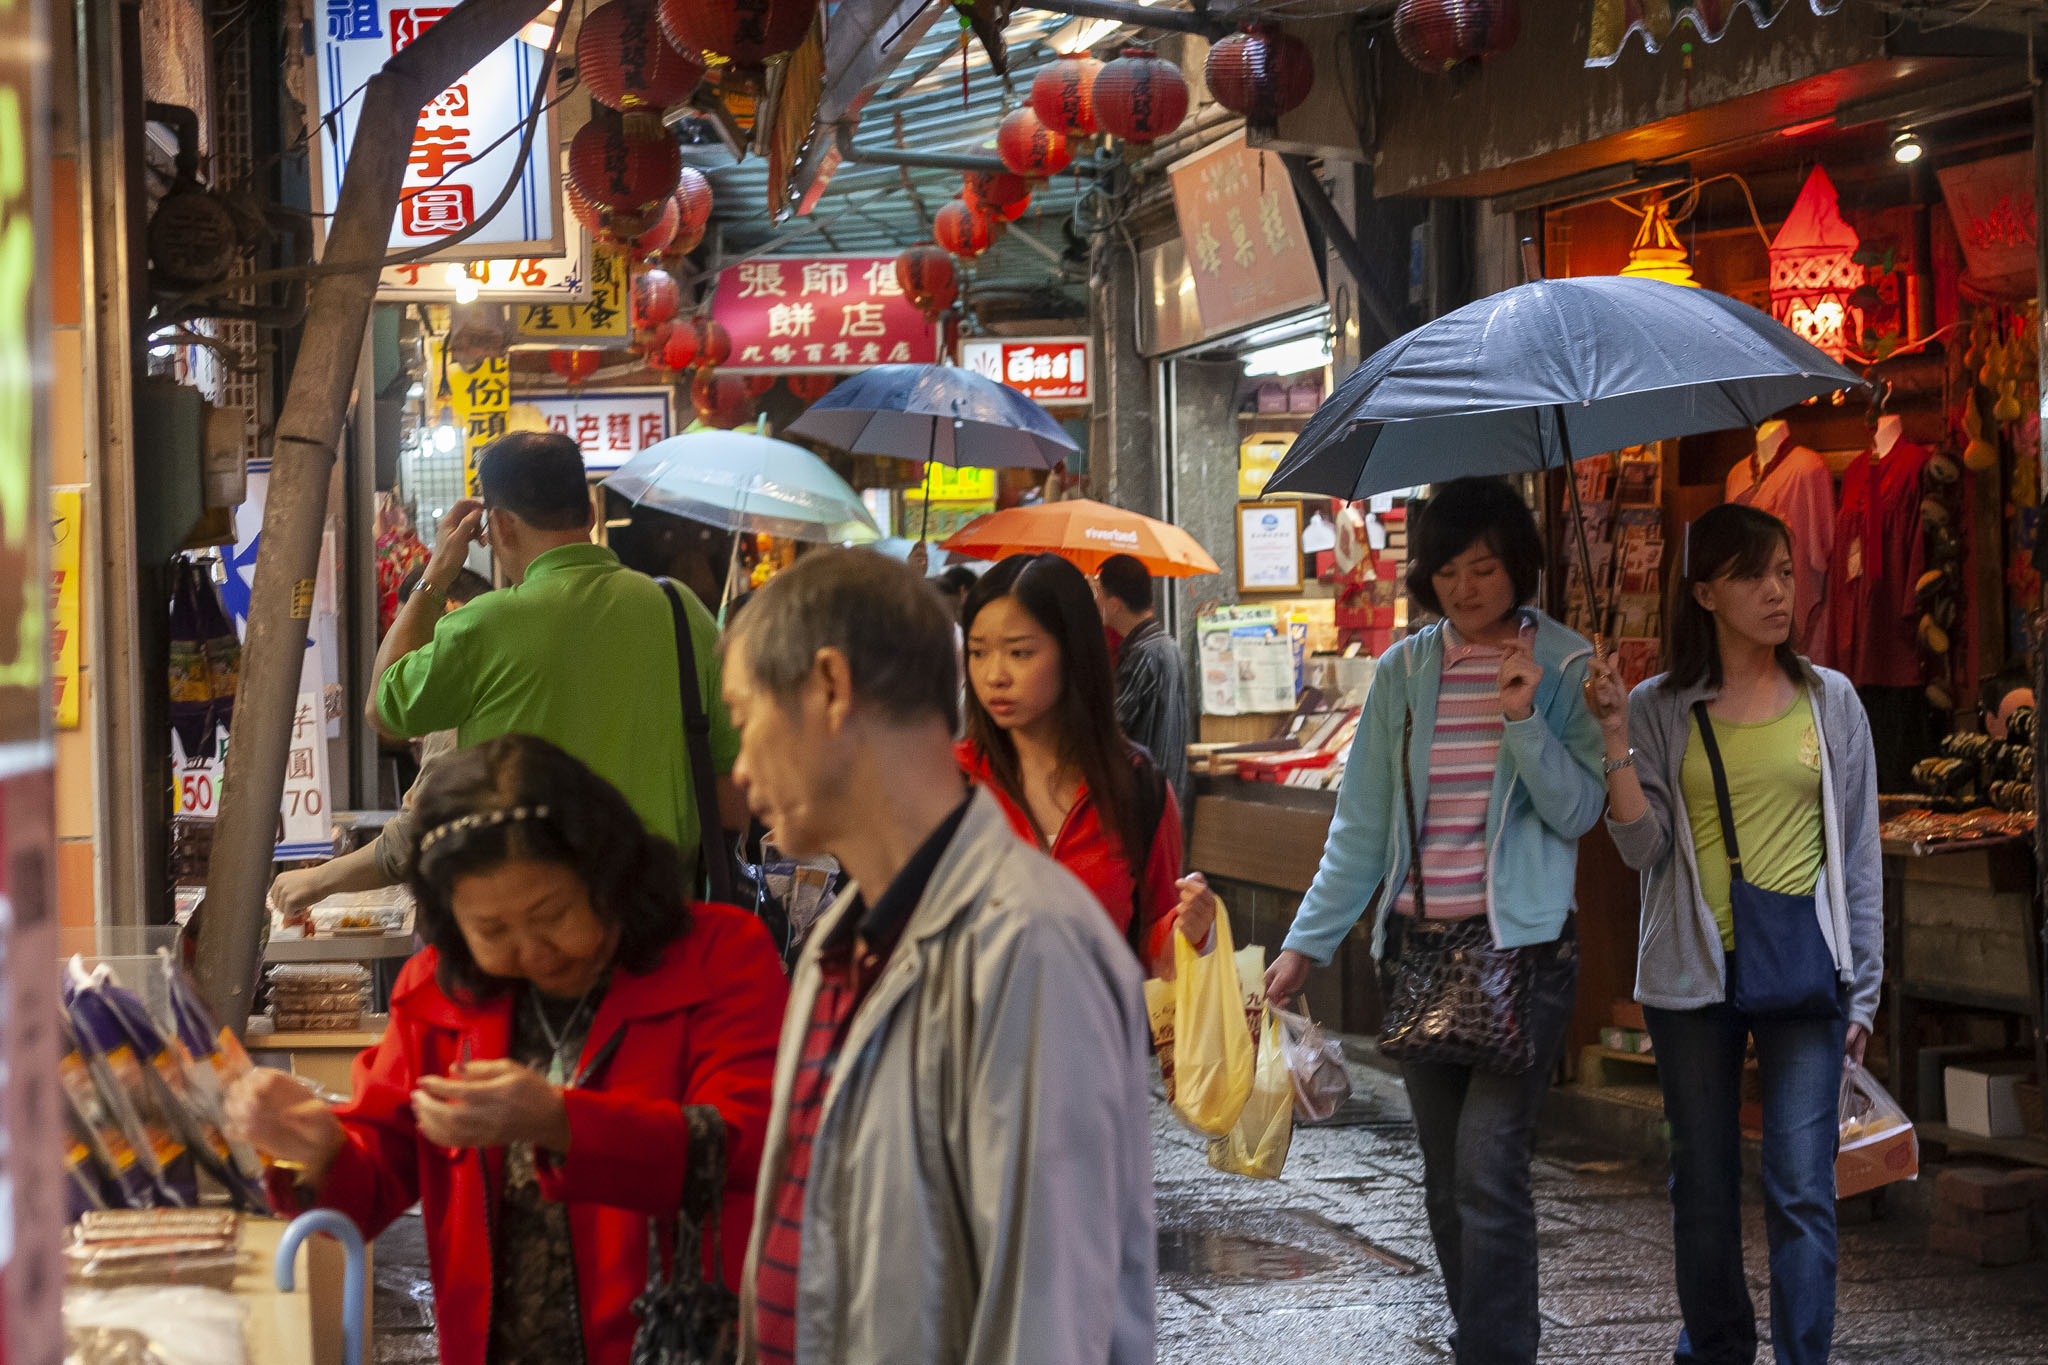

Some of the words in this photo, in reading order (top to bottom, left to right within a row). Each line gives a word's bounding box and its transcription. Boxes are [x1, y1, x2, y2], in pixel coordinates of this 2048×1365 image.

[767, 301, 887, 338] 餅店
[290, 704, 317, 781] 芋圓
[183, 775, 213, 812] 50
[285, 788, 323, 817] 70
